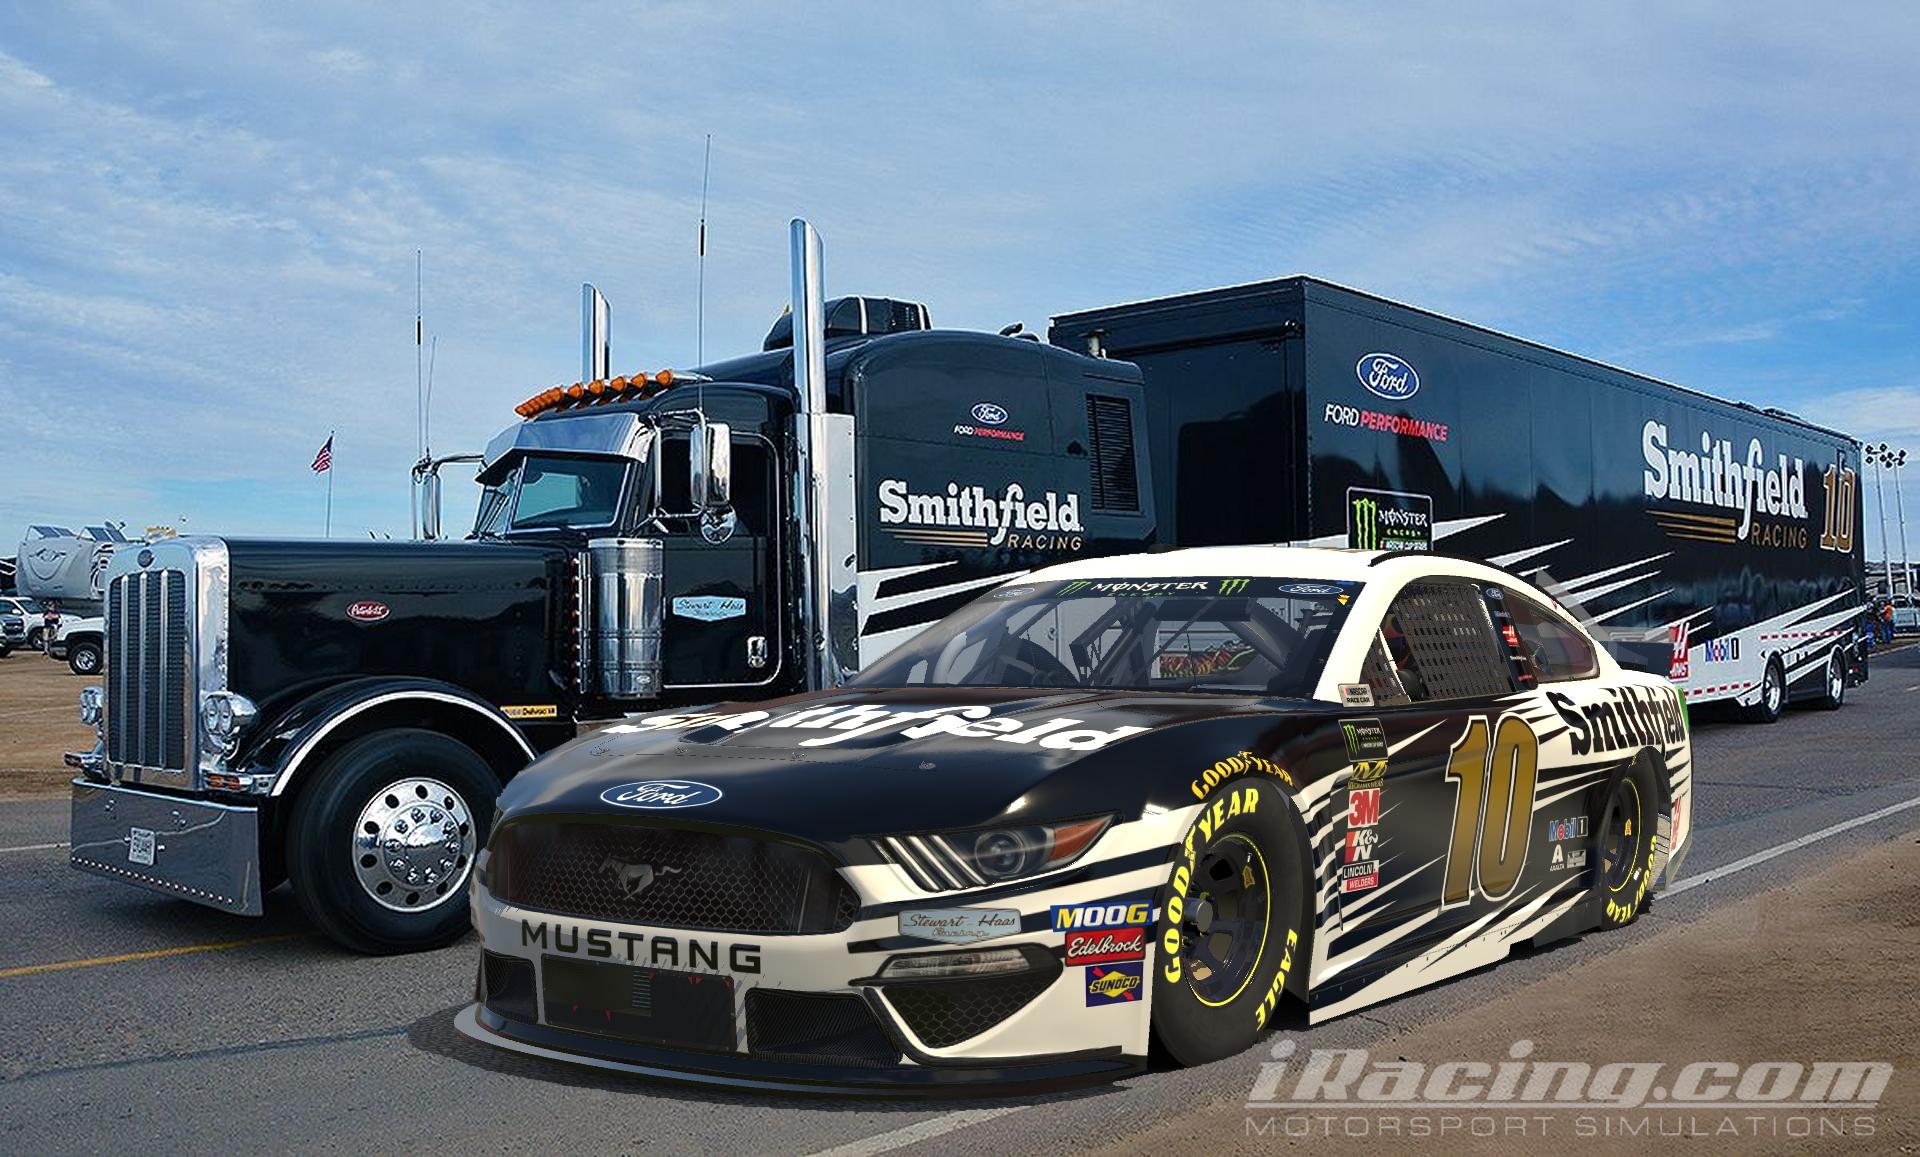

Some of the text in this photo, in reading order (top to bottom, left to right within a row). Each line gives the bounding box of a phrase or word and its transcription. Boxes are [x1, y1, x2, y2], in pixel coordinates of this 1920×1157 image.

[1369, 358, 1408, 393] Ford
[1324, 403, 1448, 441] FORD PERFORMANCE
[1643, 420, 1855, 553] Smithfield 10
[1007, 534, 1082, 550] RACING
[1752, 523, 1808, 549] RACING
[617, 783, 702, 804] Ford
[1349, 789, 1379, 826] 3M
[1442, 711, 1540, 911] 10
[1549, 817, 1576, 842] Mobil
[1343, 864, 1373, 879] LINCOLN
[1349, 876, 1375, 889] WELDERS
[979, 914, 1016, 927] Haas
[1056, 903, 1149, 929] MOOG
[521, 919, 762, 974] MUSTANG
[1068, 933, 1144, 957] Edelbrock
[1090, 976, 1139, 994] SUNOCO
[1255, 927, 1298, 1032] EAGLE
